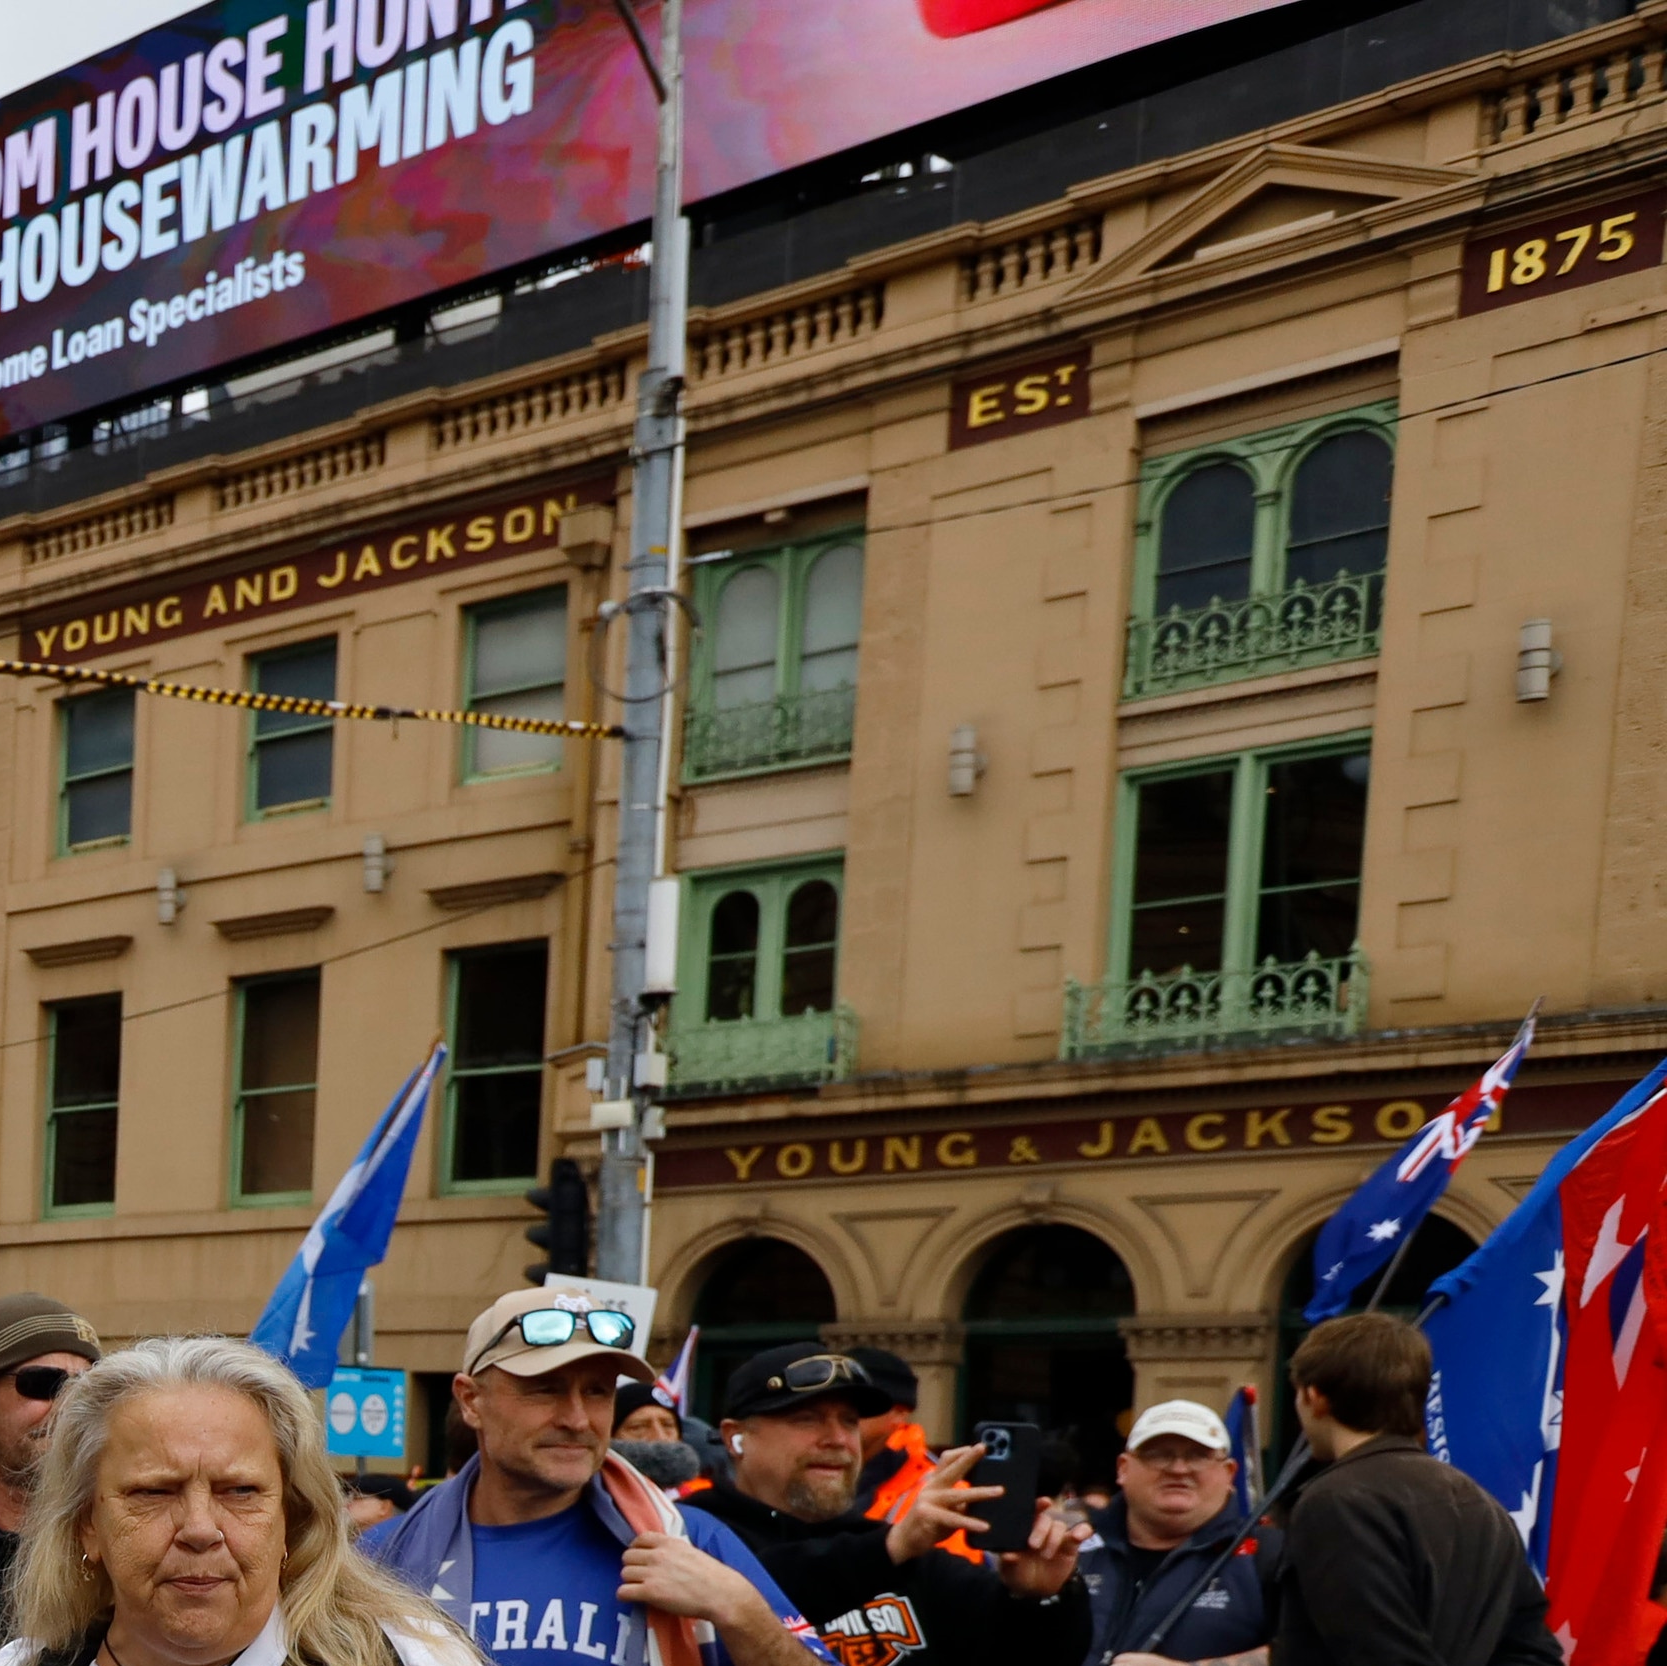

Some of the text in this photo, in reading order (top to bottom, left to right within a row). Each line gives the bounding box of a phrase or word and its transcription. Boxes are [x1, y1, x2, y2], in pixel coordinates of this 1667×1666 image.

[71, 14, 287, 191] HOUSE
[52, 315, 124, 371] Loan
[129, 250, 307, 348] Specialists
[1485, 210, 1639, 294] 1875
[34, 495, 578, 660] YOUNG AND JACKSON
[725, 1131, 979, 1182] YOUNG
[1008, 1135, 1043, 1165] &
